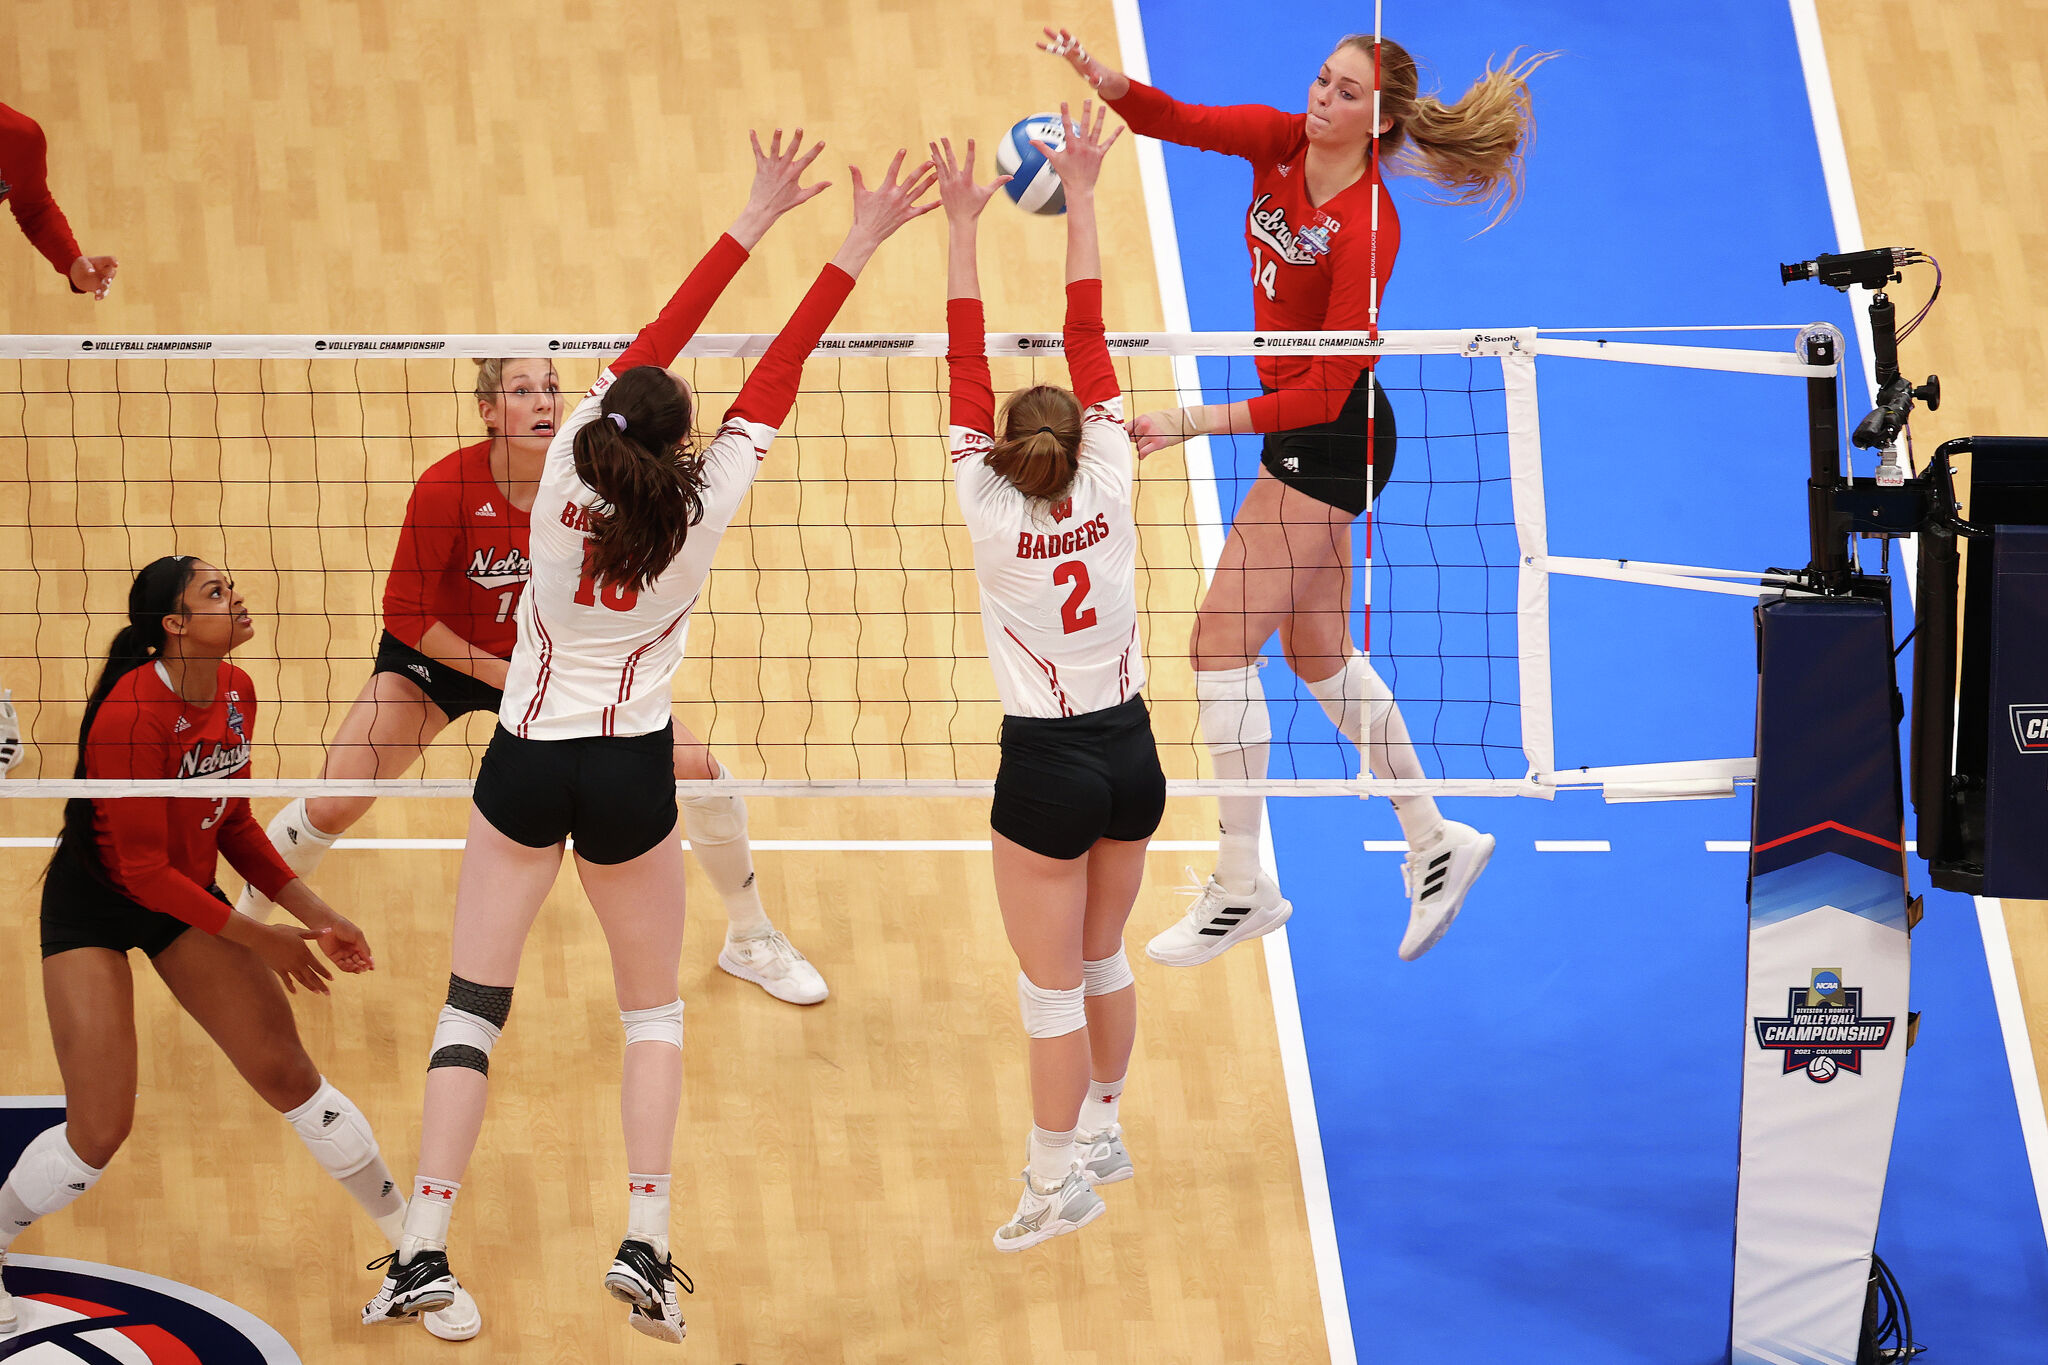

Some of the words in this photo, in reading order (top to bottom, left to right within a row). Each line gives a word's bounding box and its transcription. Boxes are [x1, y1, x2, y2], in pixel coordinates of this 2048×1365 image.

[1251, 193, 1314, 262] Nebraka
[1253, 246, 1278, 301] 14
[95, 342, 144, 350] VOLLEYBALL
[146, 342, 212, 350] CHAMPIONSHIP
[328, 341, 377, 350] VOLLEYBALL
[380, 341, 445, 350] CHAMPIONSHIP
[562, 341, 611, 349] VOLLEYBALL
[848, 340, 914, 349] CHAMPIONSHIP
[1105, 339, 1149, 348] PIONSHIP
[1267, 338, 1316, 347] VOLLEYBALL
[1319, 338, 1385, 347] CHAMPIONSHIP
[1016, 512, 1110, 560] BADGERS
[1053, 560, 1097, 635] 2
[496, 591, 518, 624] 1
[201, 797, 227, 830] 3
[1815, 982, 1839, 990] NCAA
[1793, 1014, 1856, 1025] VOLLEYBALL
[1764, 1026, 1886, 1042] CHAMPIONSHIP
